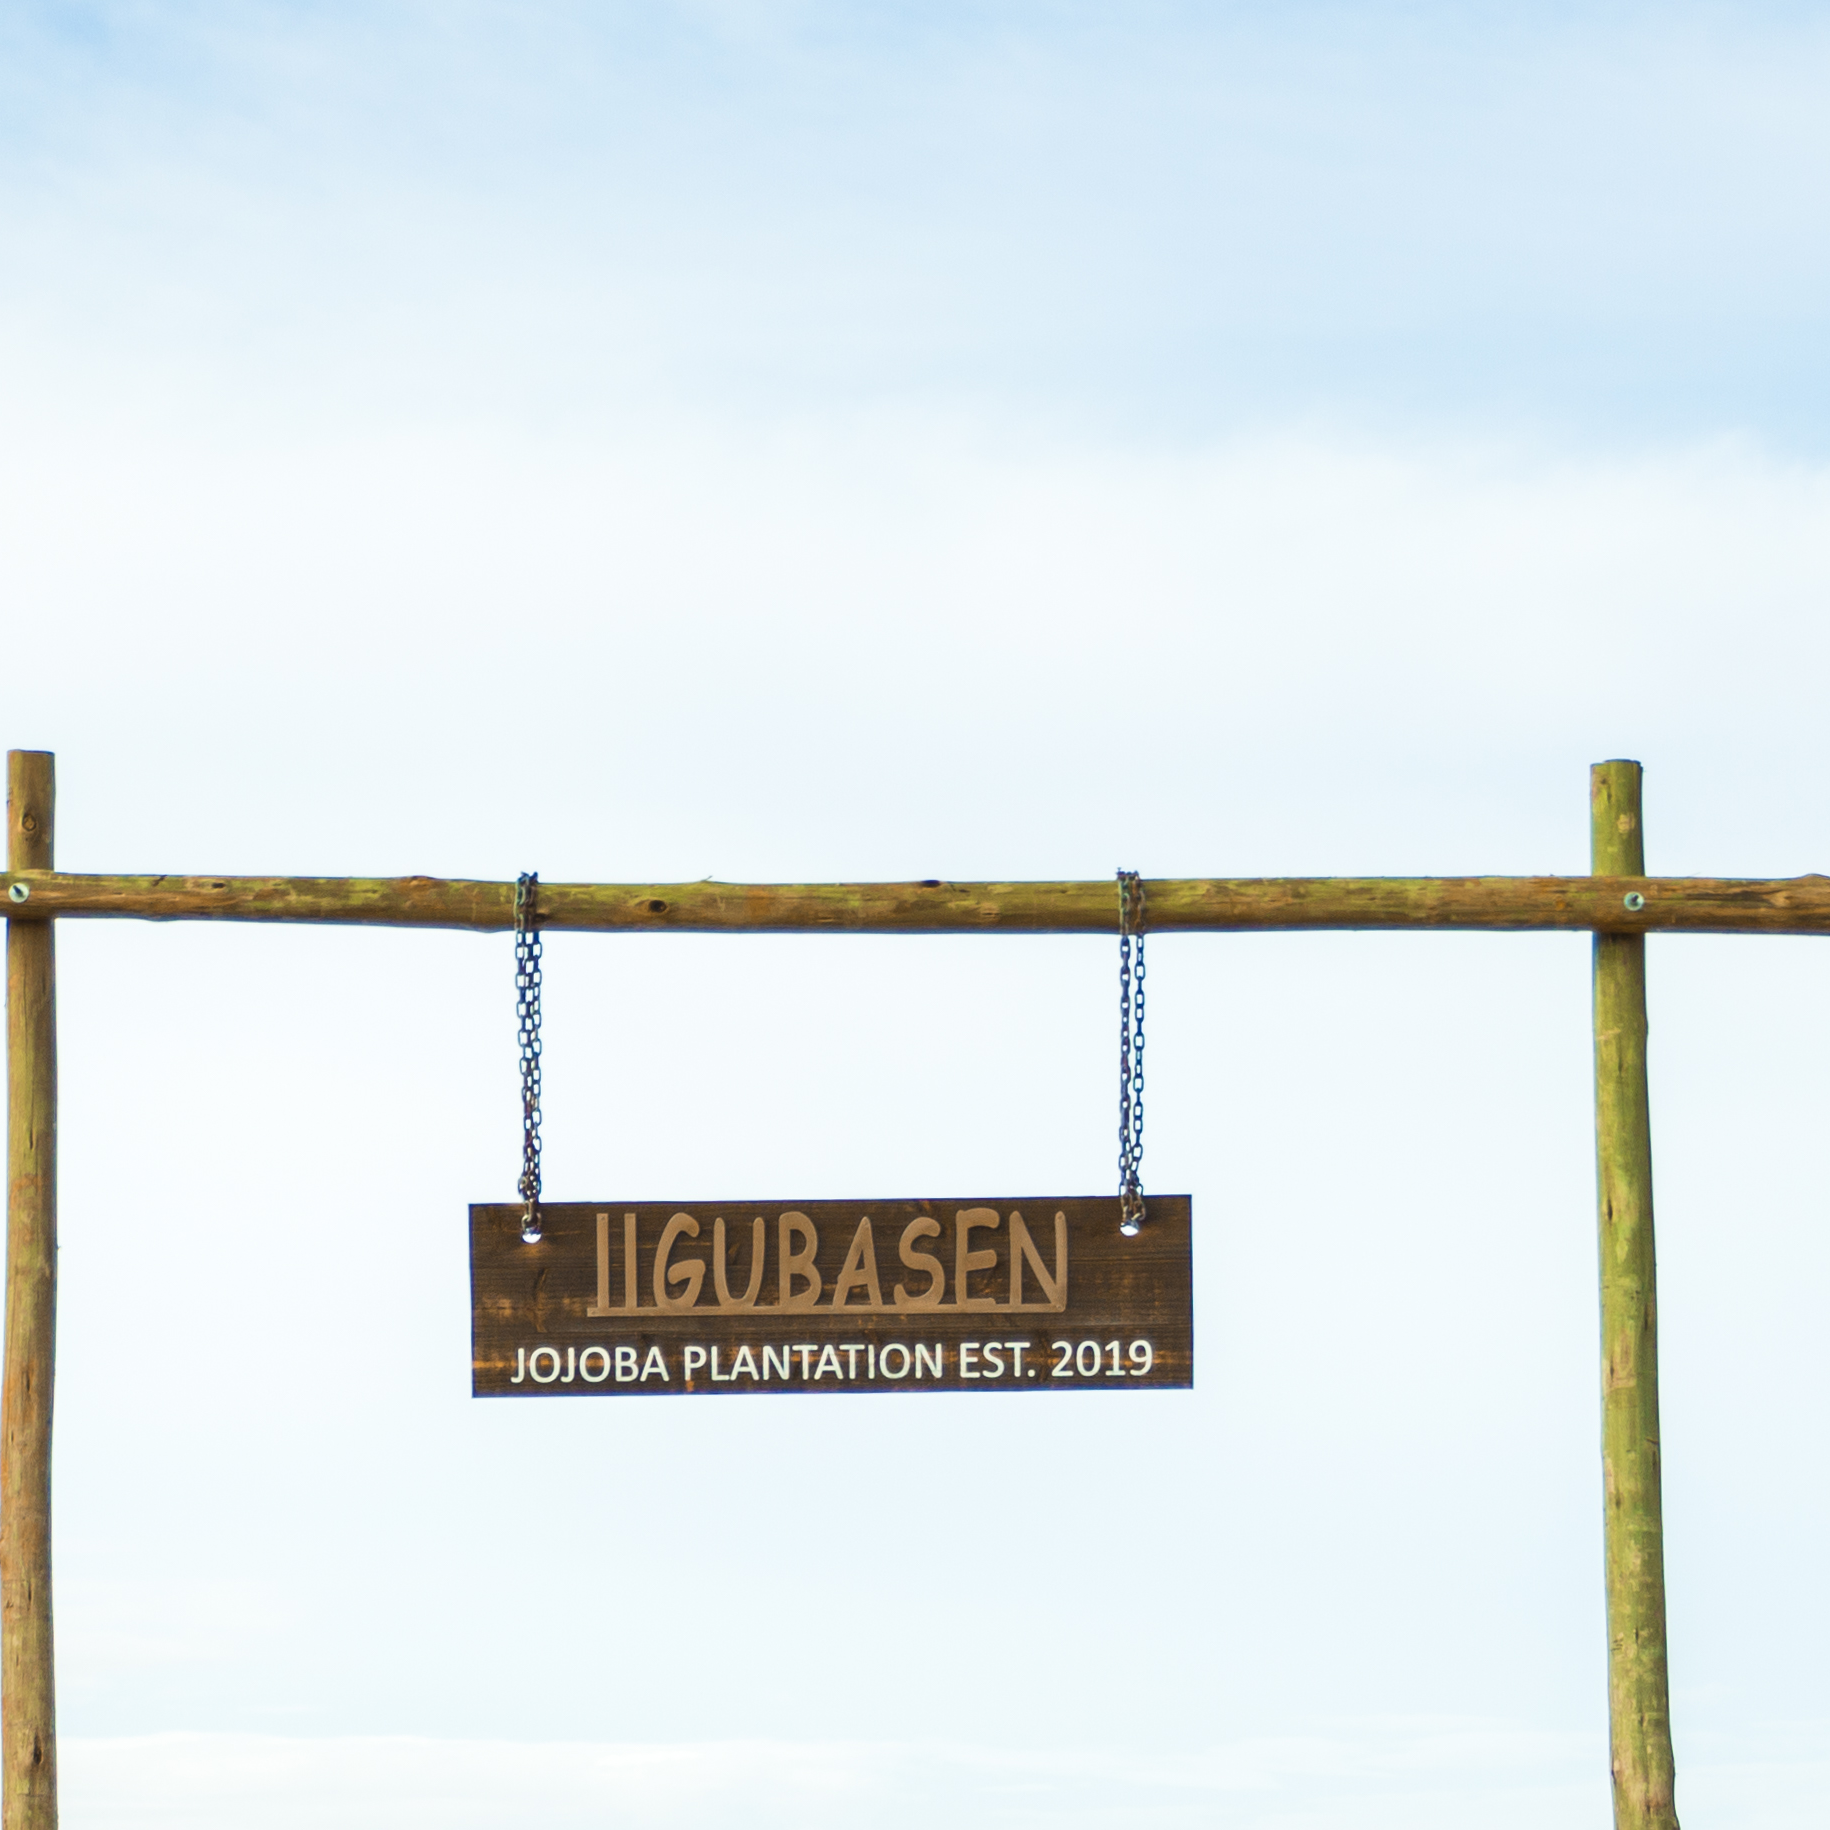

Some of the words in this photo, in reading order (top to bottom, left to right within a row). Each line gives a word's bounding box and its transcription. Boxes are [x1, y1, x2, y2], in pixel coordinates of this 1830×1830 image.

[510, 1346, 670, 1384] JOJOBA
[683, 1342, 943, 1382] PLANTATION
[959, 1341, 1037, 1379] EST.
[1050, 1339, 1154, 1378] 2019
